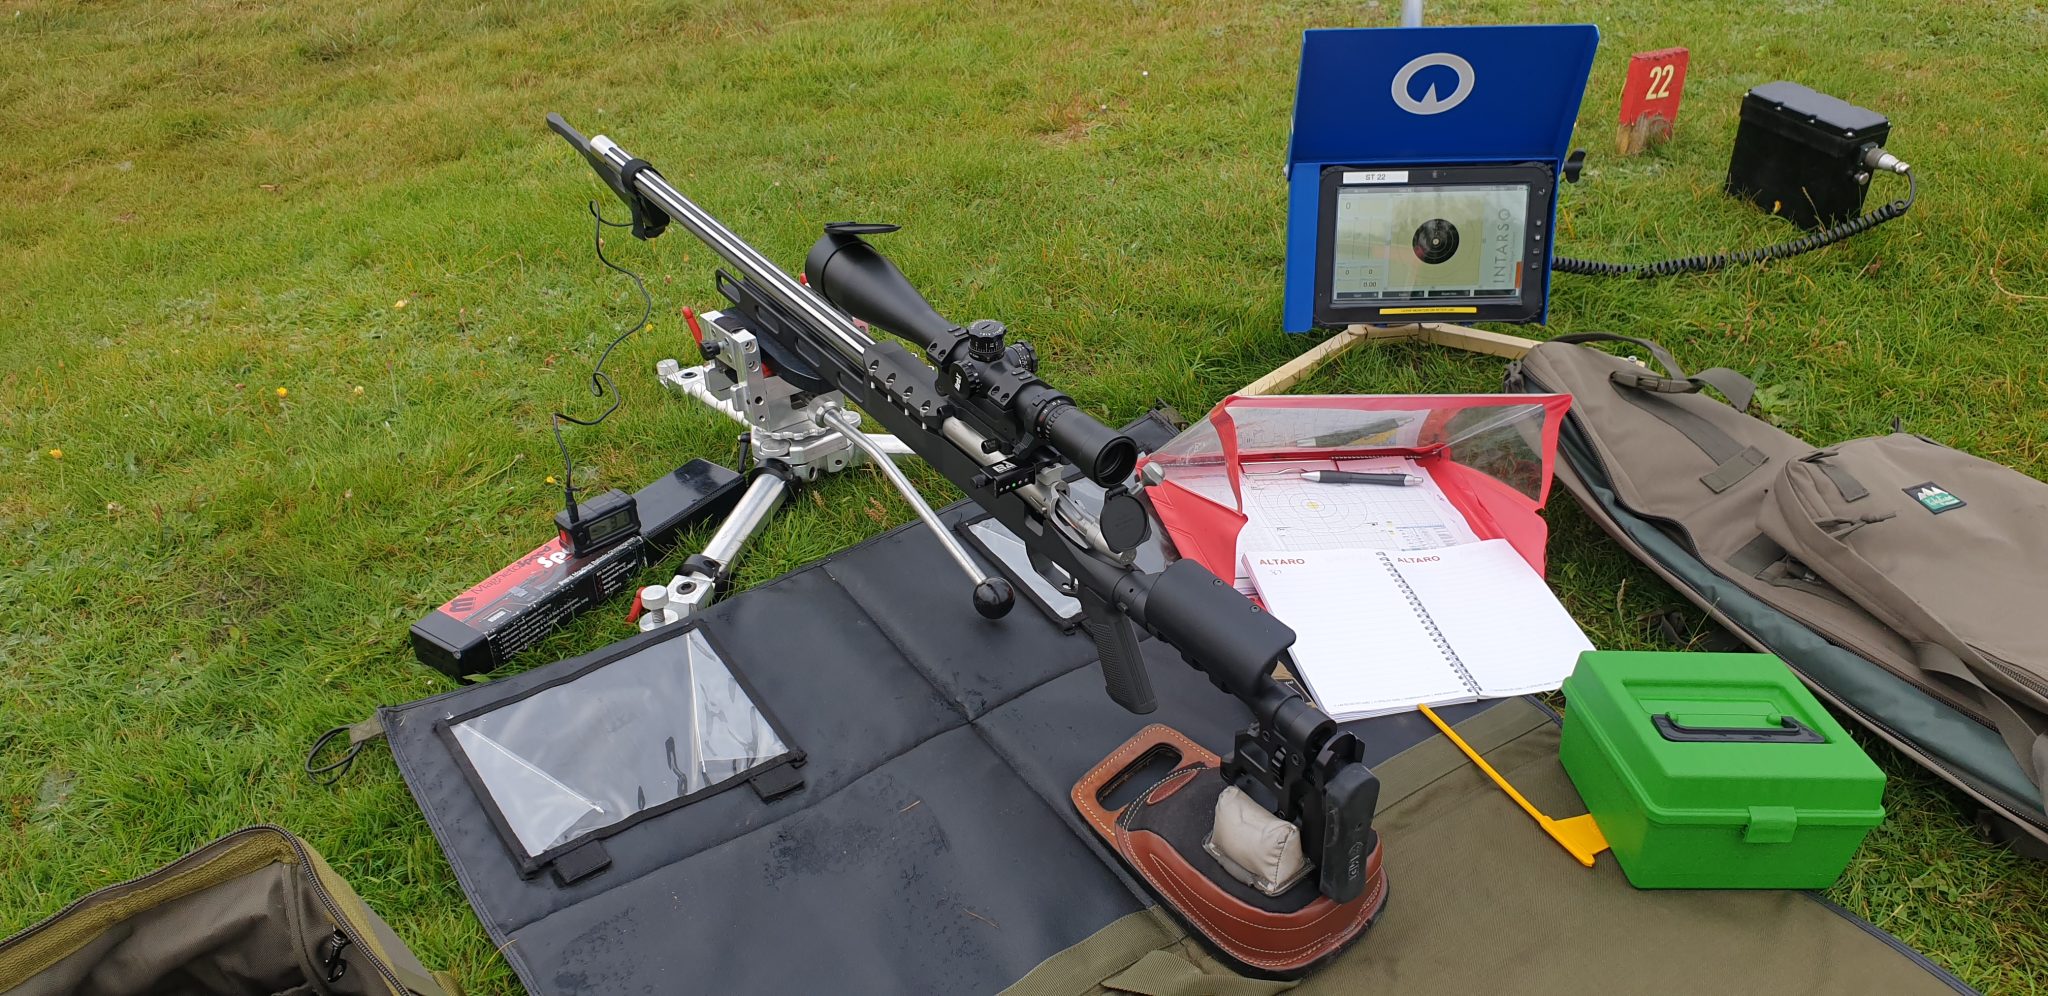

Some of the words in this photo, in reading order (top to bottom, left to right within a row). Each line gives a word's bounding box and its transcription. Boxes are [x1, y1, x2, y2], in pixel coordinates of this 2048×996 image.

[1645, 64, 1675, 100] 22
[1377, 173, 1386, 181] 22
[1493, 208, 1511, 283] INTARSO
[1259, 558, 1305, 566] ALTARO
[1397, 555, 1441, 564] ALTARO
